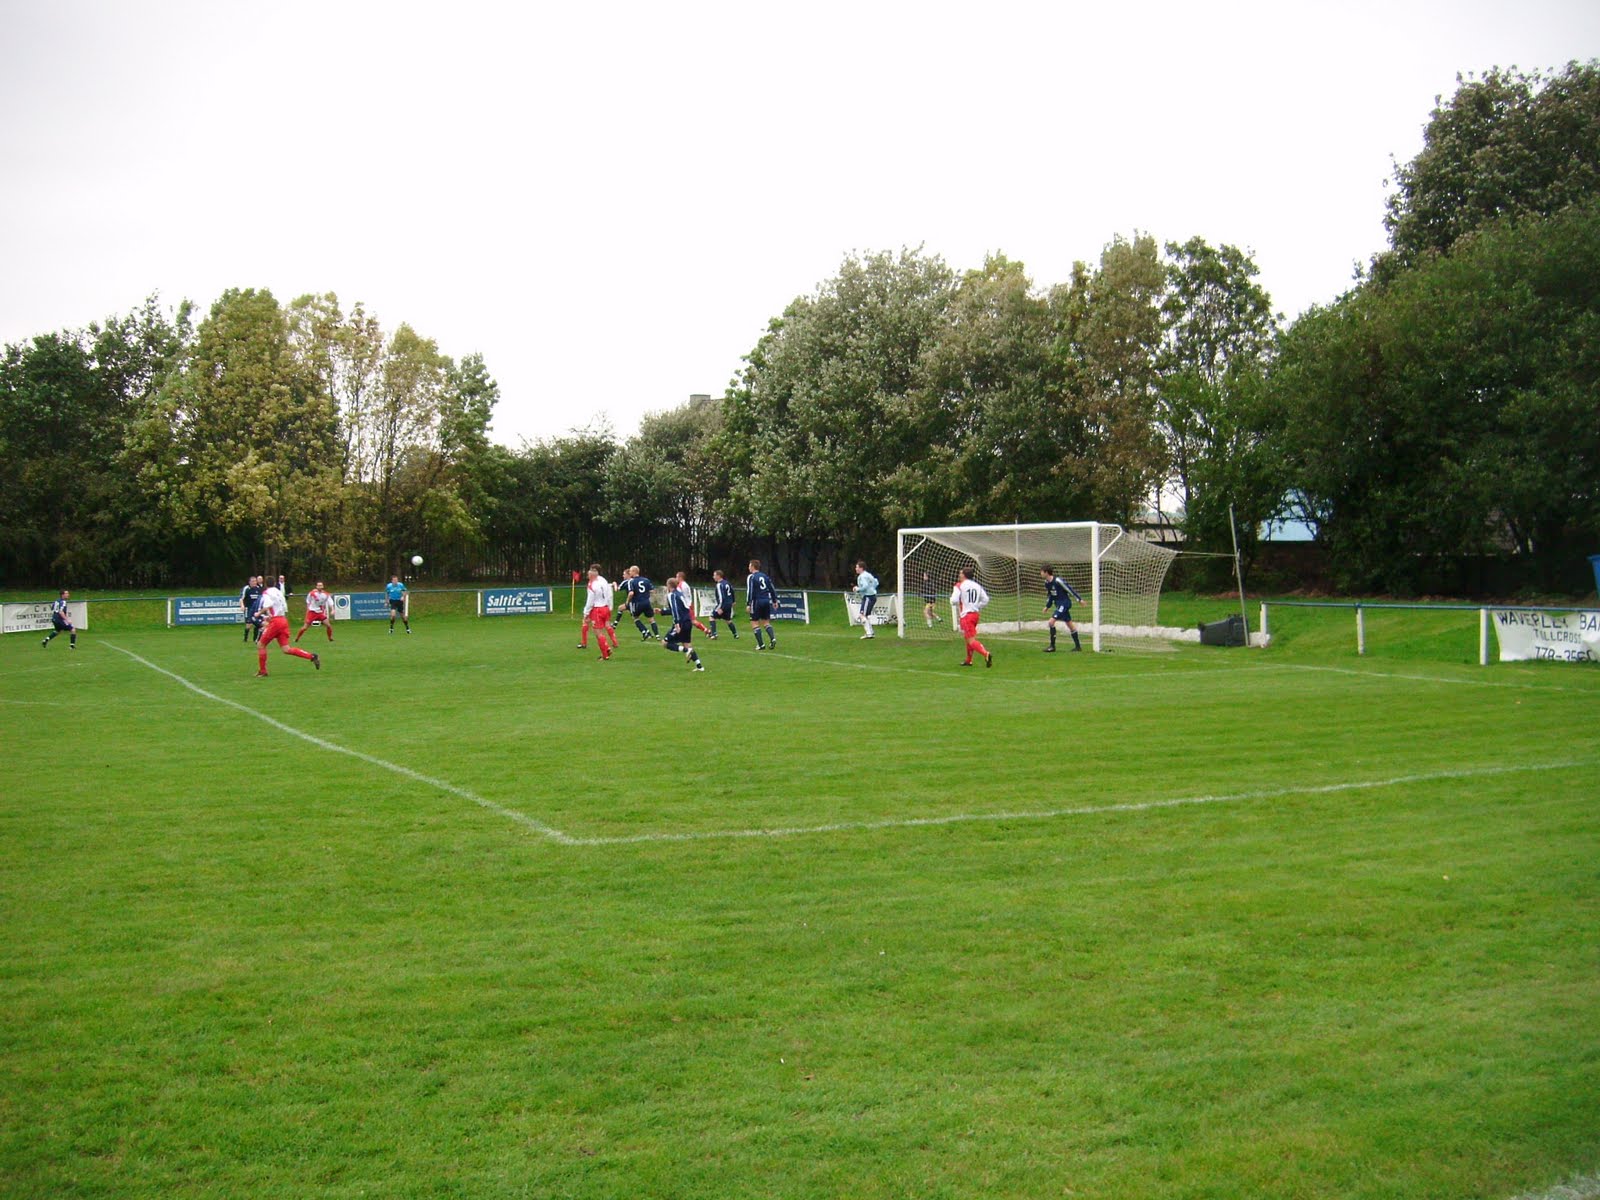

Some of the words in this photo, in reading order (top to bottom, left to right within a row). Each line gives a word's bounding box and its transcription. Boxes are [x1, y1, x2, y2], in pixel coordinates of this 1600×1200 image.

[638, 581, 646, 593] 5
[760, 577, 766, 589] 3
[725, 584, 732, 596] 2
[487, 595, 523, 607] Saltire
[966, 589, 978, 604] 10
[1579, 614, 1600, 631] BA
